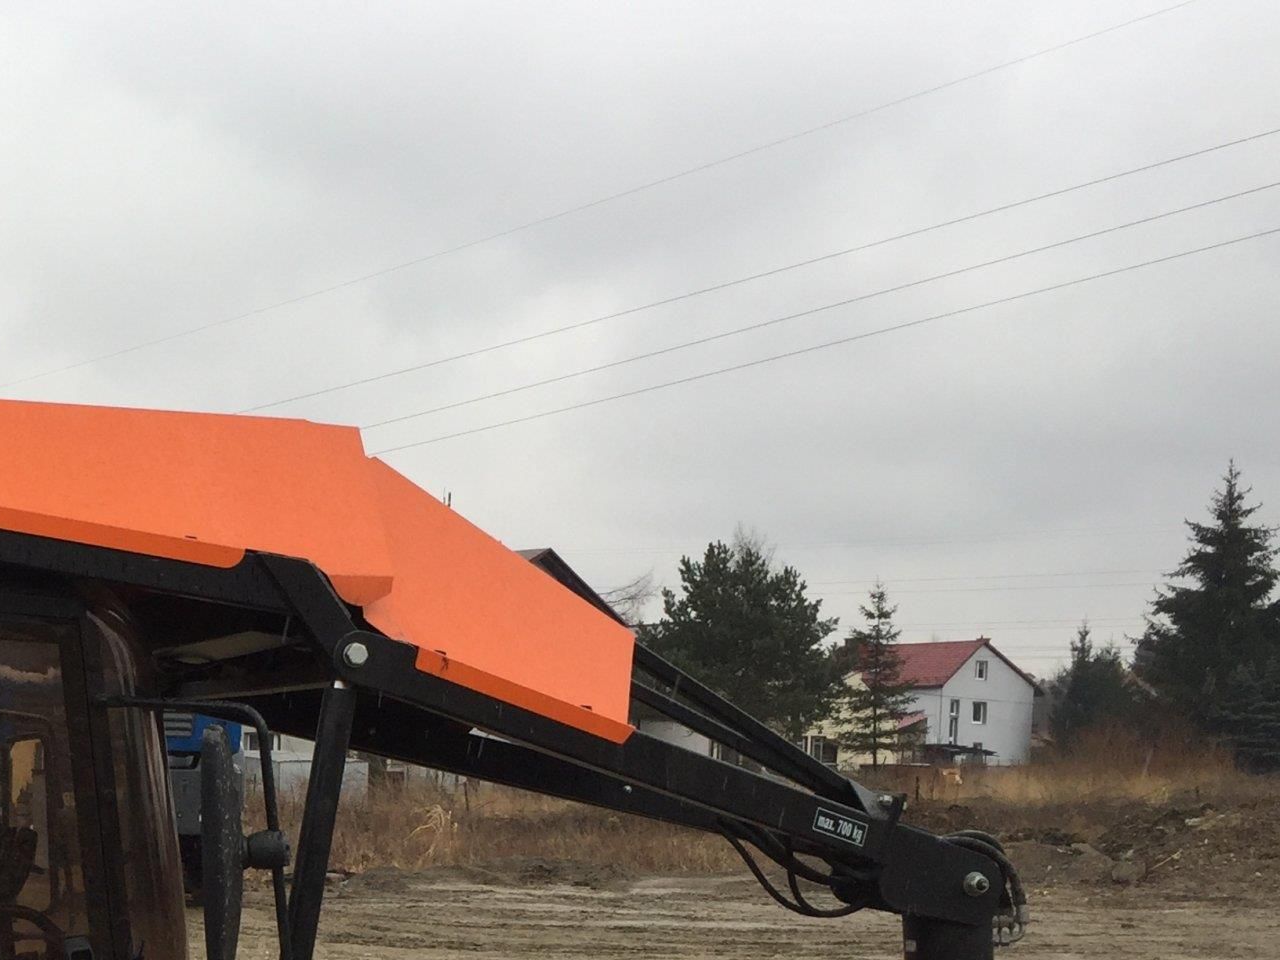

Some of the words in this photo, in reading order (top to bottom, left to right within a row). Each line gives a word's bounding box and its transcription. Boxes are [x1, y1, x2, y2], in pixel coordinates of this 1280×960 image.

[817, 816, 835, 831] max.
[836, 819, 853, 837] 700
[852, 825, 863, 844] kg
